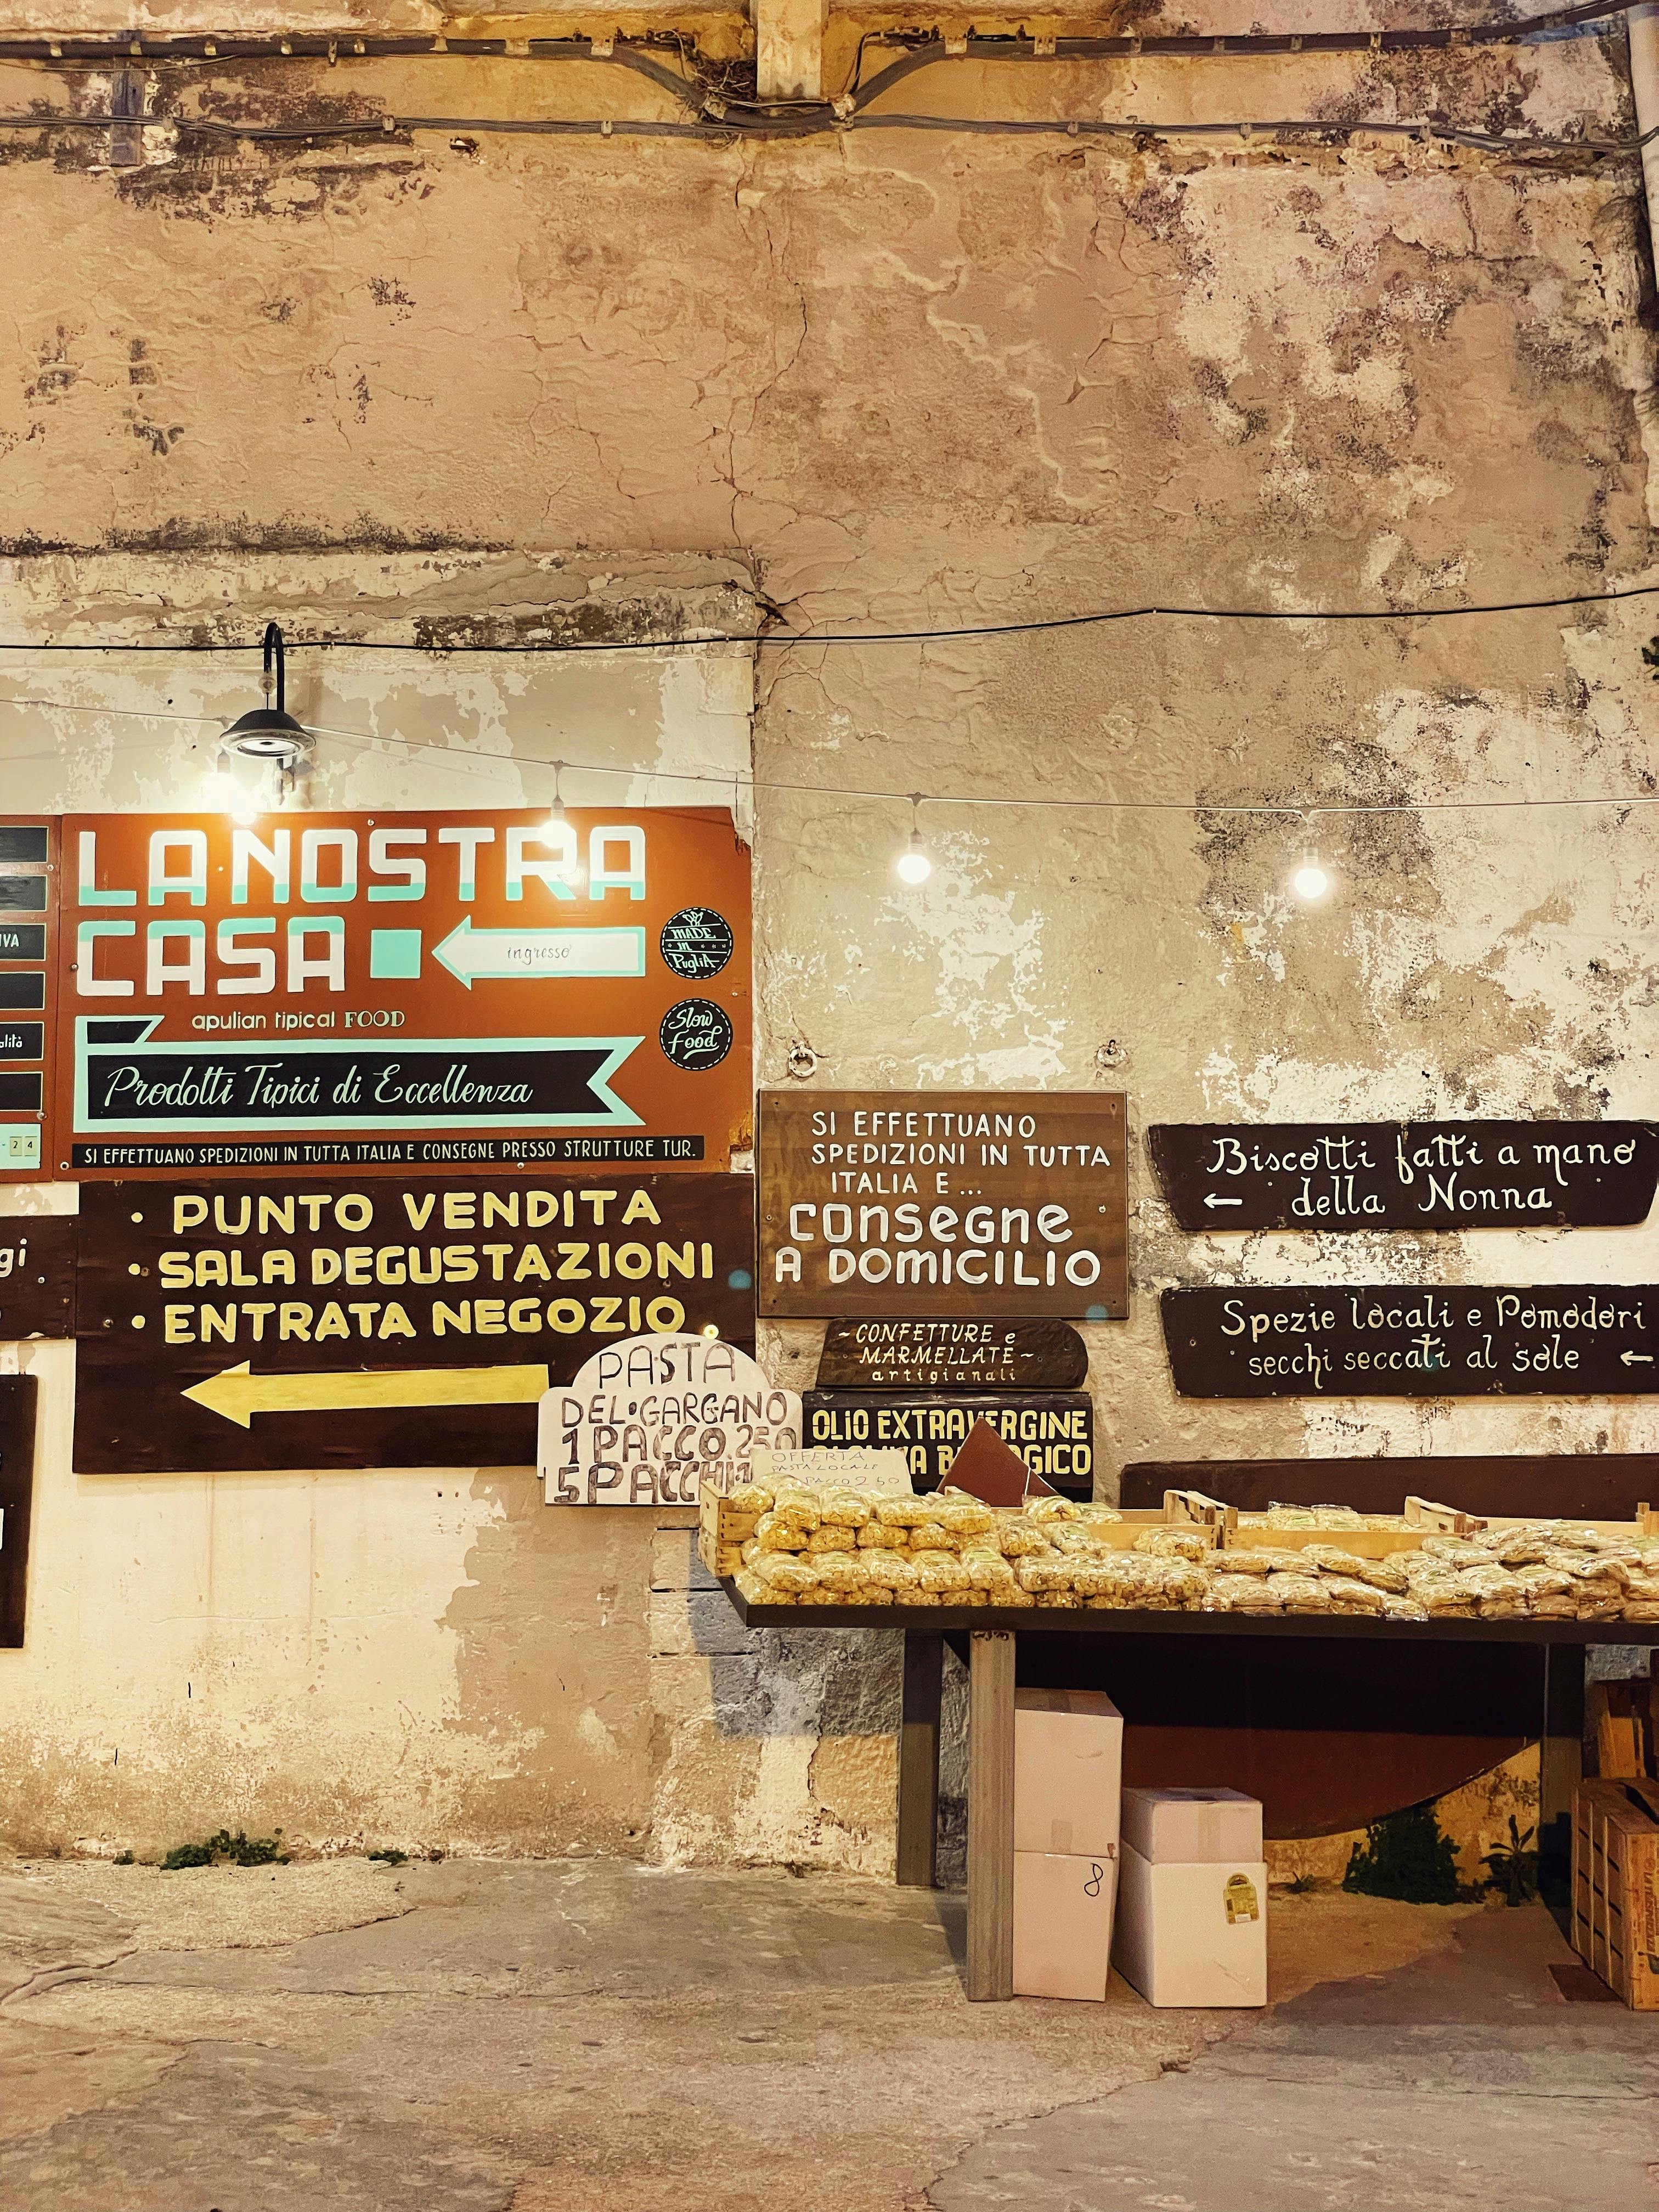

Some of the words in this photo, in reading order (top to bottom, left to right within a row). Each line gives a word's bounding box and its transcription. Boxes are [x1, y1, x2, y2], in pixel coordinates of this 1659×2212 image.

[78, 829, 208, 906] LA
[231, 825, 646, 905] NOSTRA
[76, 916, 345, 996] CASA
[508, 944, 572, 966] ingresso
[191, 1011, 266, 1032] apulian
[275, 1011, 335, 1031] tipical
[345, 1010, 405, 1028] FOOD
[668, 1007, 713, 1029] Slow
[104, 1066, 236, 1107] Prodotti
[245, 1062, 320, 1109] Tipici
[332, 1065, 362, 1104] di
[373, 1064, 533, 1104] Eccellenza
[811, 1111, 836, 1136] SI
[854, 1111, 1036, 1138] EFFETTUANO
[84, 1148, 97, 1164] SI
[104, 1148, 194, 1164] EFFETTUANO
[199, 1147, 278, 1164] SPEDIZIONI
[284, 1146, 297, 1161] IN
[303, 1145, 350, 1161] TUTTA
[357, 1144, 401, 1160] ITALIA
[407, 1144, 414, 1160] E
[423, 1142, 495, 1160] CONSEGNE
[503, 1141, 556, 1158] PRESSO
[564, 1139, 654, 1157] STRUTTURE
[663, 1139, 697, 1157] TUR.
[811, 1143, 964, 1165] SPEDIZIONI
[981, 1144, 1007, 1166] IN
[1023, 1145, 1110, 1167] TUTTA
[1206, 1135, 1376, 1175] Biscotti
[1395, 1134, 1483, 1184] fatti
[1498, 1146, 1521, 1165] a
[1533, 1139, 1636, 1186] mano
[832, 1171, 918, 1194] ITALIA
[936, 1172, 949, 1194] E
[1291, 1175, 1385, 1216] della
[1418, 1171, 1552, 1212] Nonna
[173, 1193, 373, 1235] PUNTO
[402, 1189, 662, 1231] VENDITA
[158, 1249, 296, 1289] SALA
[311, 1241, 713, 1285] DEGUSTAZIONI
[775, 1246, 801, 1283] A
[165, 1301, 417, 1344] ENTRATA
[432, 1296, 685, 1334] NEGOZIO
[856, 1323, 994, 1344] CONFETTURE
[1005, 1333, 1015, 1344] e
[1221, 1300, 1335, 1343] Spezie
[1350, 1295, 1454, 1329] locali
[1467, 1309, 1482, 1327] e
[1496, 1295, 1646, 1330] Pomodori
[598, 1342, 736, 1389] PASTA
[859, 1346, 1014, 1365] MARMELLATE
[1249, 1342, 1333, 1389] secchi
[1344, 1333, 1451, 1370] seccati
[1466, 1334, 1498, 1369] al
[1512, 1334, 1579, 1372] sole
[872, 1368, 1015, 1384] artigianali
[640, 1392, 787, 1426] GARGANO
[562, 1429, 579, 1465] 1
[594, 1425, 726, 1463] PACCO
[772, 1451, 865, 1462] OFFERTA
[554, 1466, 580, 1502] 5
